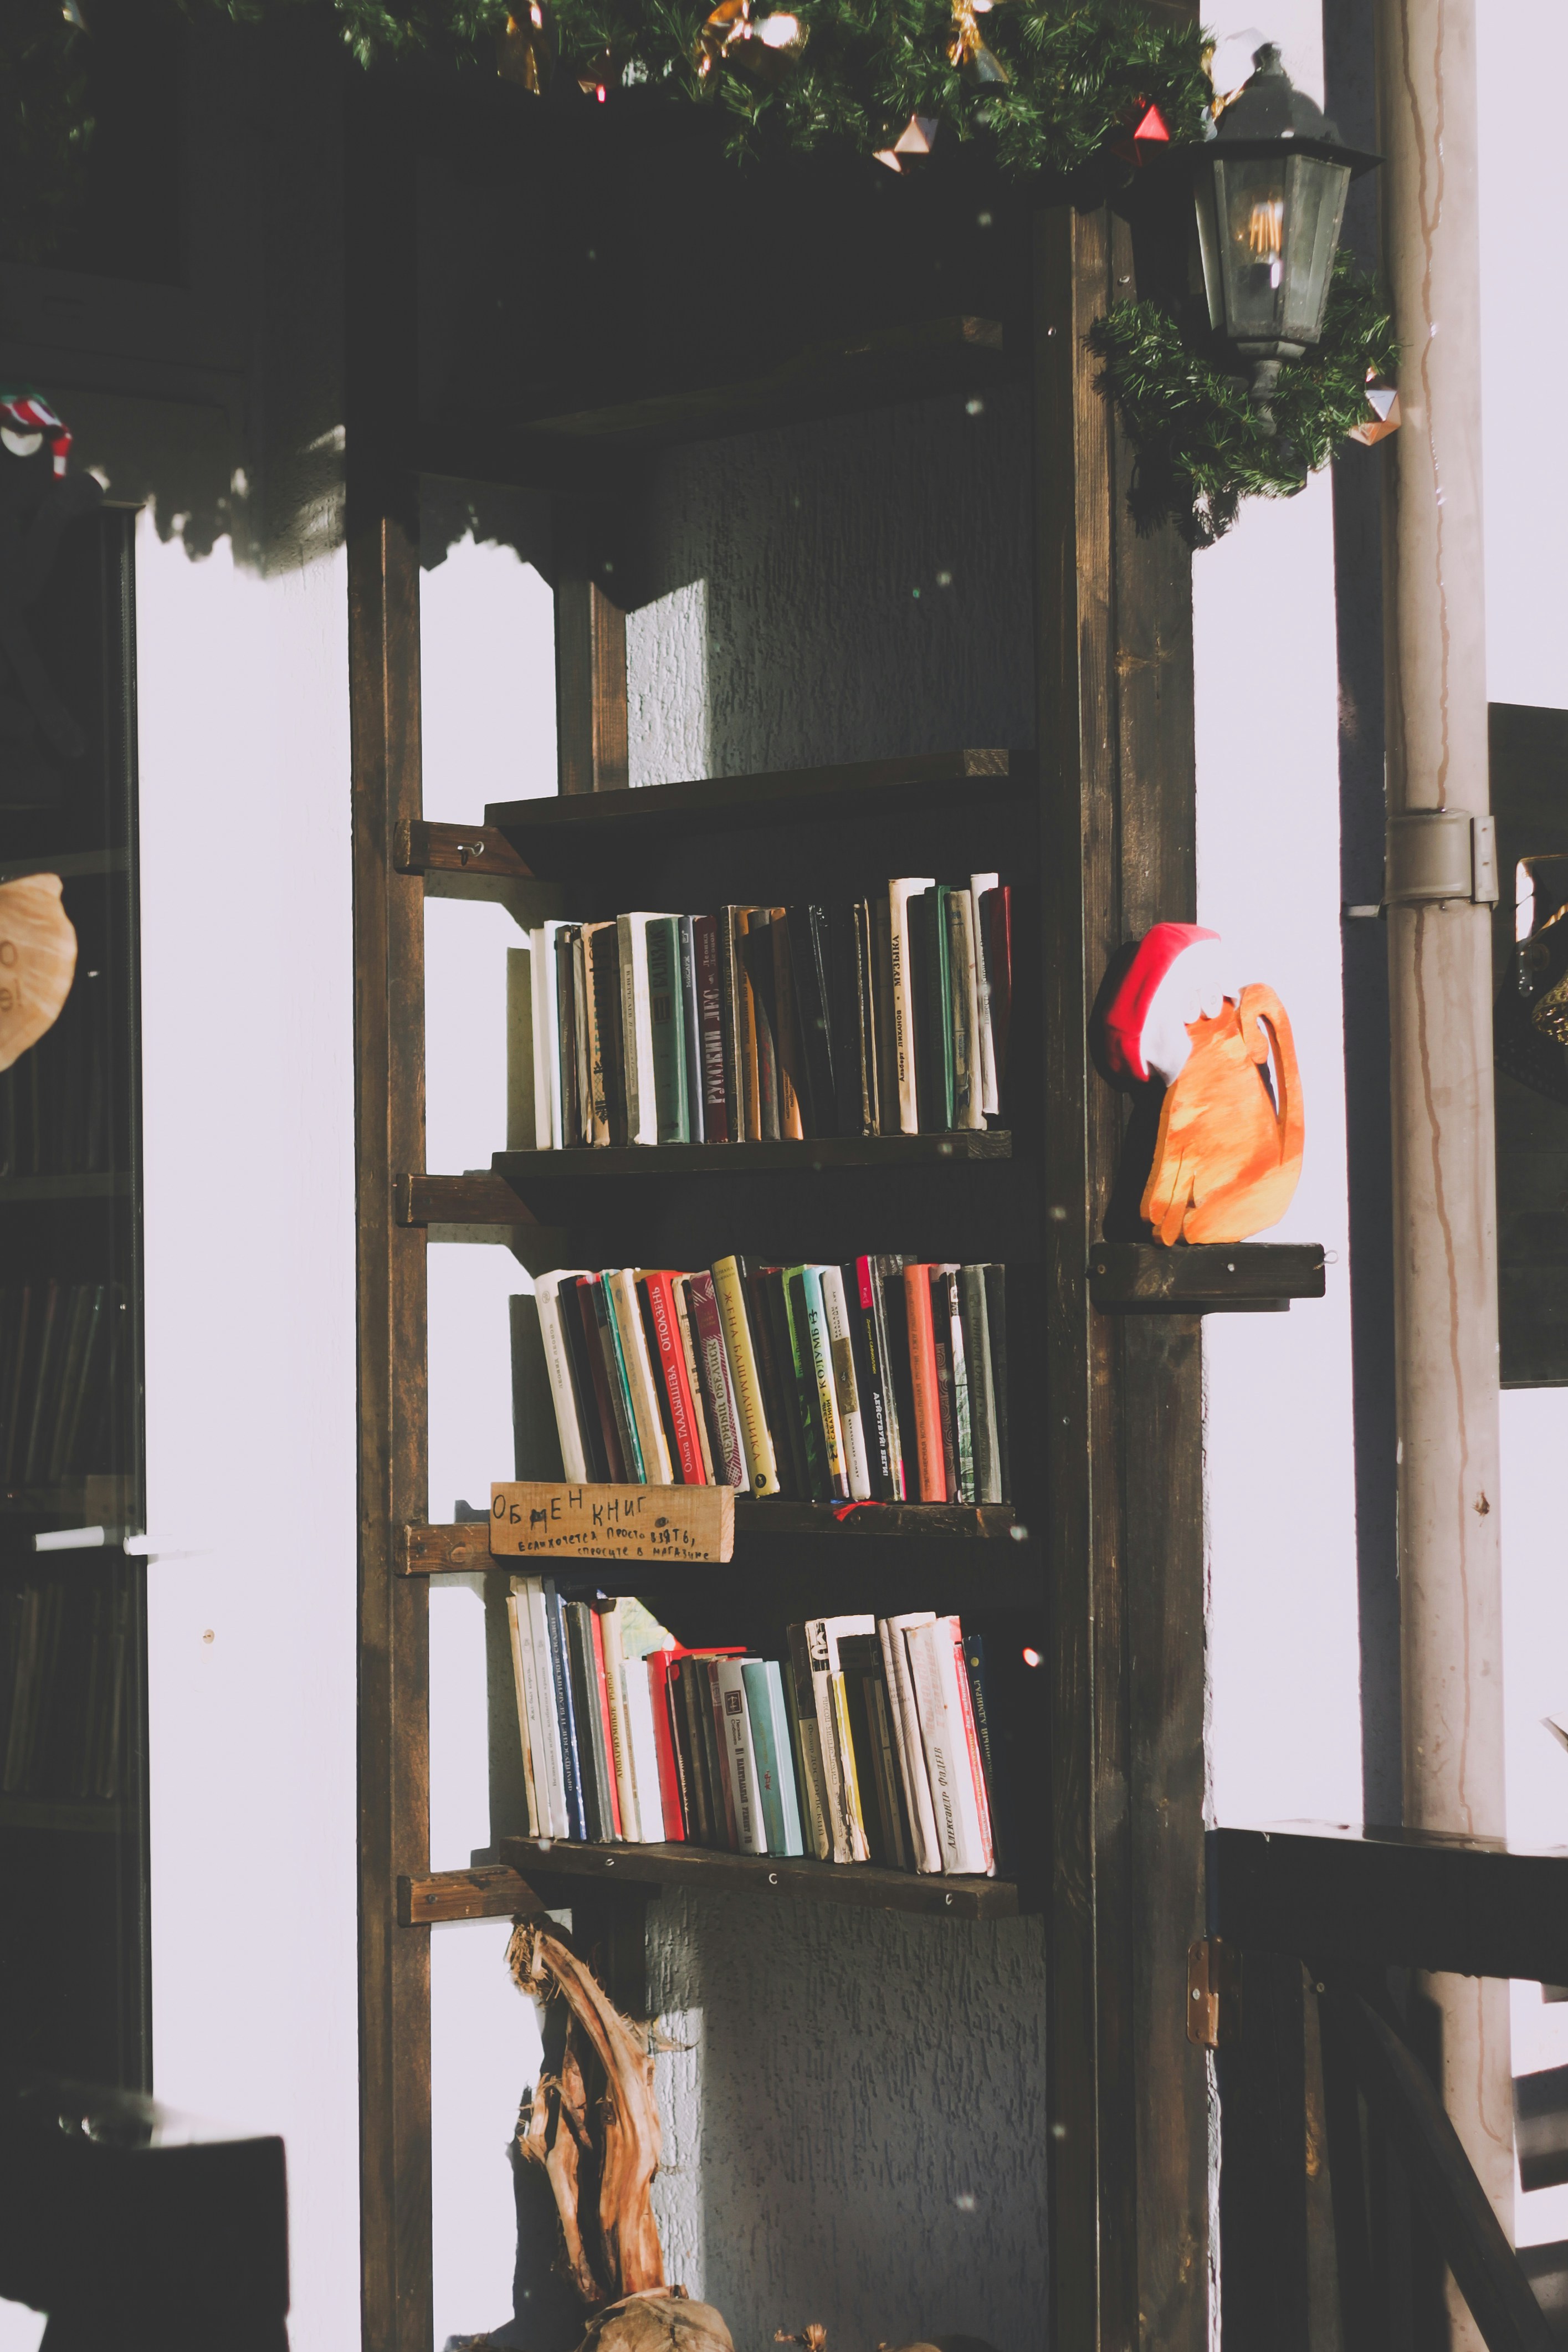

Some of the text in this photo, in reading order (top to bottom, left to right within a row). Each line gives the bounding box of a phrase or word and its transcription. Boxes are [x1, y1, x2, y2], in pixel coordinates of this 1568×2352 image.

[649, 929, 668, 988] БАЛЬЗАК
[702, 932, 710, 968] Леонид
[891, 934, 901, 986] МУЗЫКА
[702, 987, 720, 1022] ЛЕС
[895, 1009, 904, 1047] ЛИХАНОВ
[810, 1327, 827, 1389] КОЛУМБ
[971, 1316, 982, 1361] ВОЙНЫ
[653, 1286, 694, 1473] Ольга ГЛАДЫШЕВА ОПОЛЗЕНЬ
[706, 1341, 735, 1459] ЧЕРНЫЙ ОБЕЛИСК
[722, 1290, 740, 1339] ЖЕНА
[732, 1344, 762, 1462] БАШМАЧНИКА
[974, 1364, 985, 1400] НЕБО
[825, 1398, 836, 1439] САБАТИНИ
[872, 1391, 888, 1477] ДЕЙСТВУЙ! БЕГИ!
[592, 1496, 647, 1526] КНИГ
[549, 1616, 560, 1653] СКАЗКИ
[560, 1717, 567, 1725] И
[606, 1671, 623, 1779] АКВАРИУМНЫЕ РЫБЫ
[972, 1679, 987, 1725] АДМИРАЛ
[735, 1718, 743, 1741] Леонид
[561, 1727, 575, 1791] ФРАНЦУЗСКИЕ
[806, 1723, 827, 1837] Федор ДОСТОЕВСКИЙ
[736, 1757, 751, 1833] КАПИТАЛЬНЫЙ РЕМОНТ
